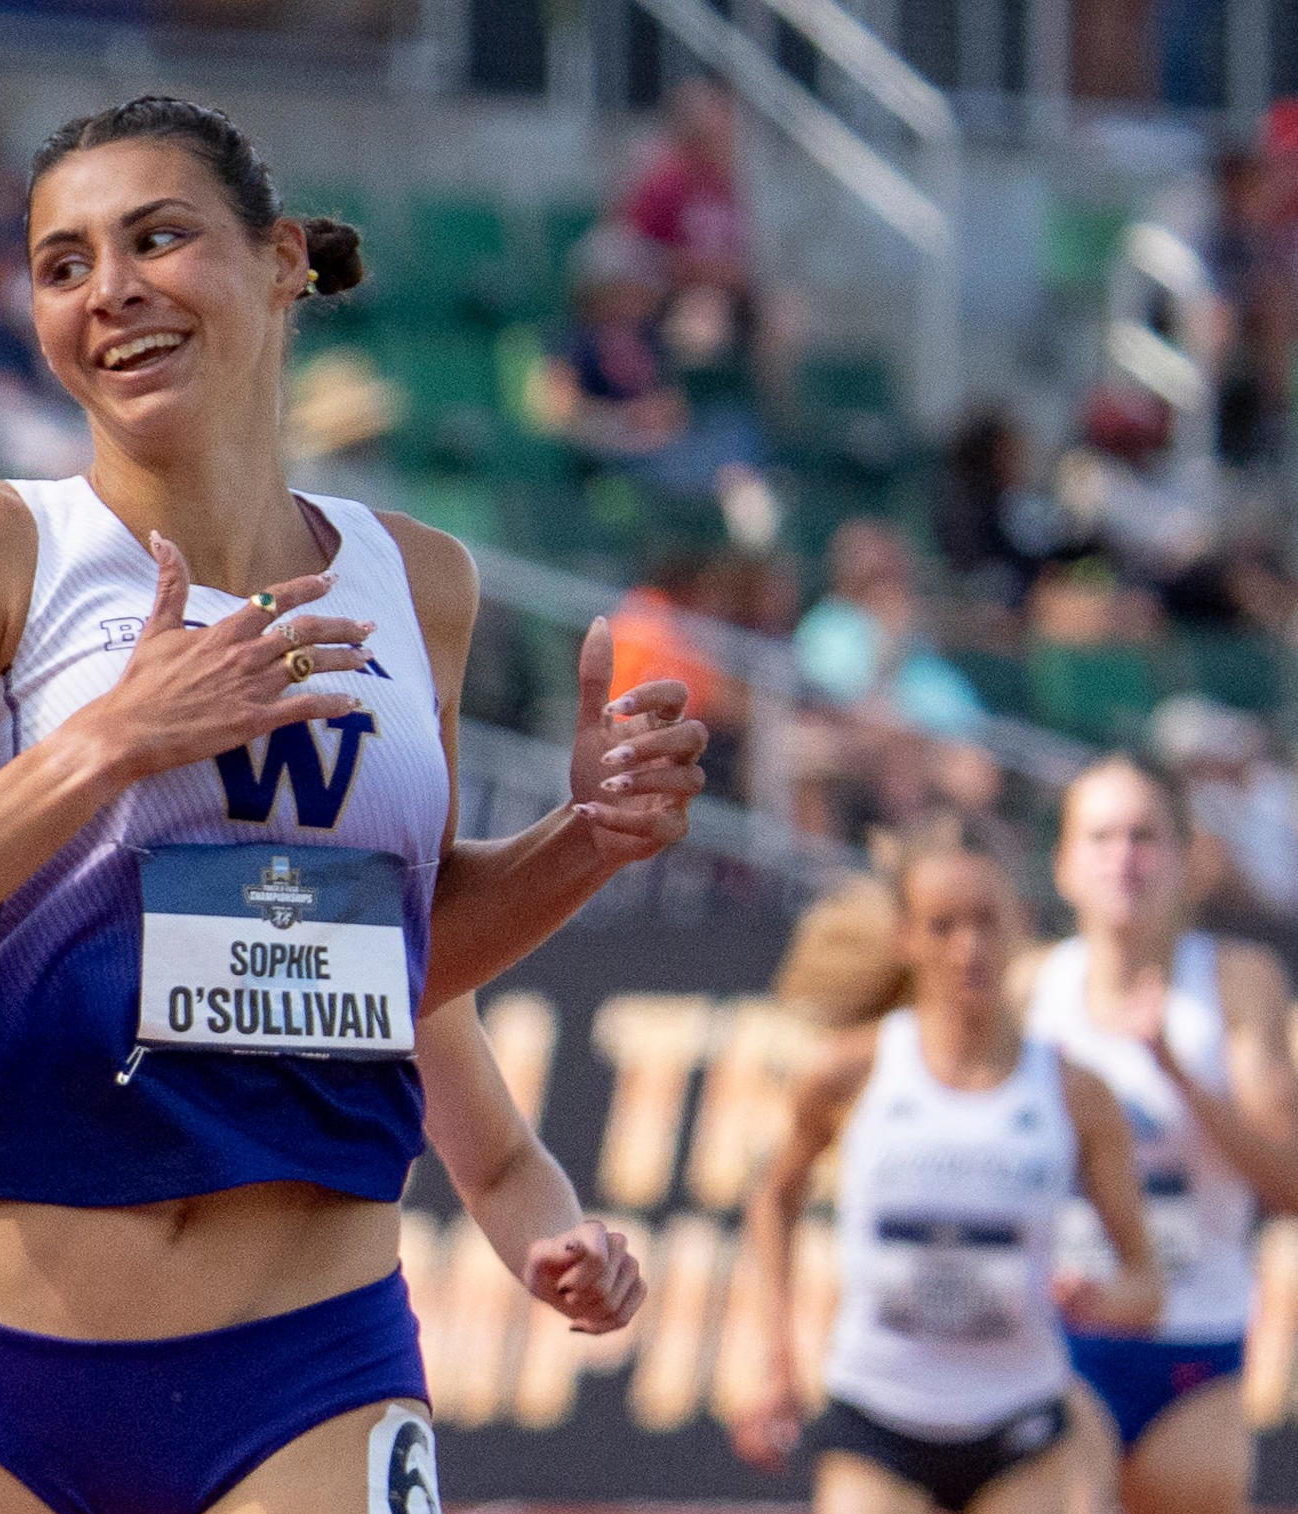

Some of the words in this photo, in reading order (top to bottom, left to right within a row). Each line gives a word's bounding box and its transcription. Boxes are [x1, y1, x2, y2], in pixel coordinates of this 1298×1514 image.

[213, 709, 379, 830] W
[230, 940, 331, 980] SOPHIE
[169, 985, 391, 1039] O'SULLIVAN
